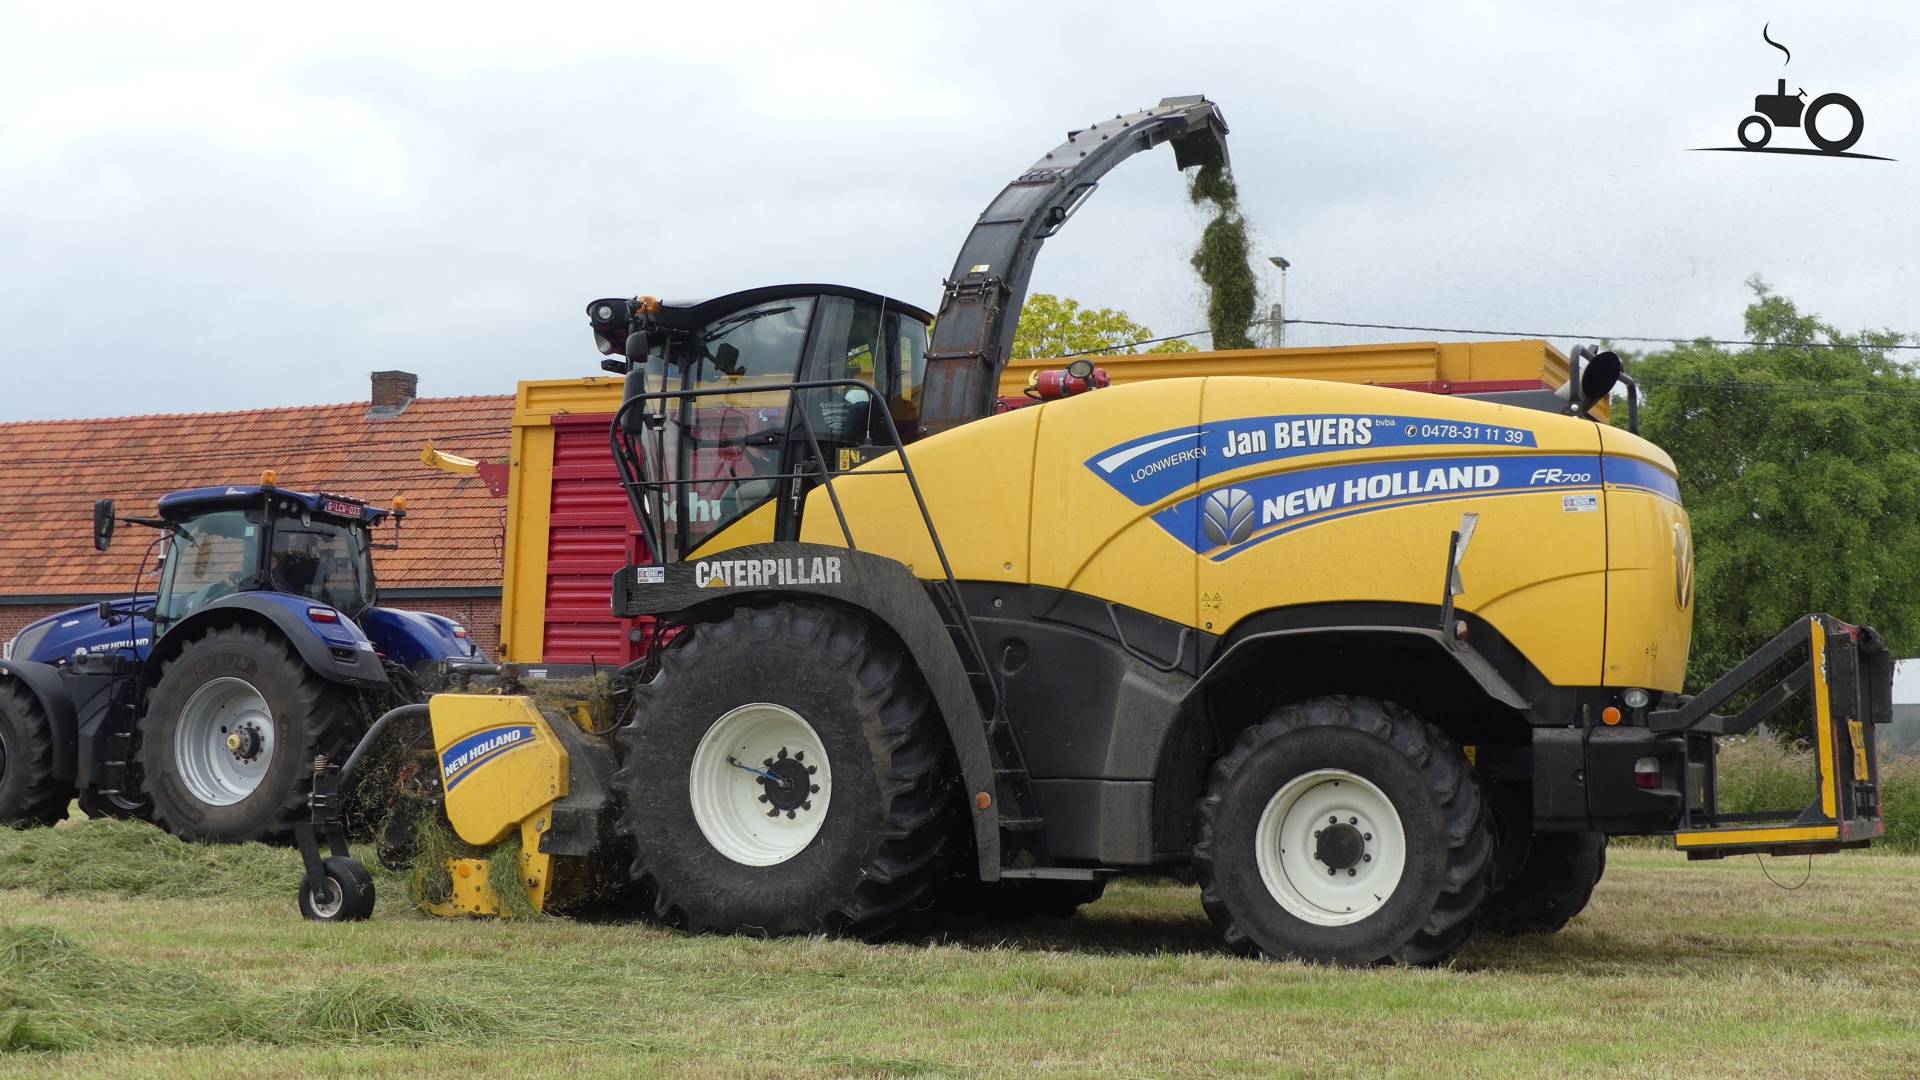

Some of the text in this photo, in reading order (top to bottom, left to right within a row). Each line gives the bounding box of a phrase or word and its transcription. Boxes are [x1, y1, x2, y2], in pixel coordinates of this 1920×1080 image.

[1222, 418, 1396, 458] Jan BEVERS bvba
[1421, 424, 1524, 444] 0478-31 11 39
[1530, 468, 1592, 485] FR700
[1262, 465, 1500, 525] NEW HOLLAND
[695, 556, 841, 588] CATERPILLAR
[91, 643, 110, 652] NEW
[444, 729, 521, 778] NEW HOLLAND
